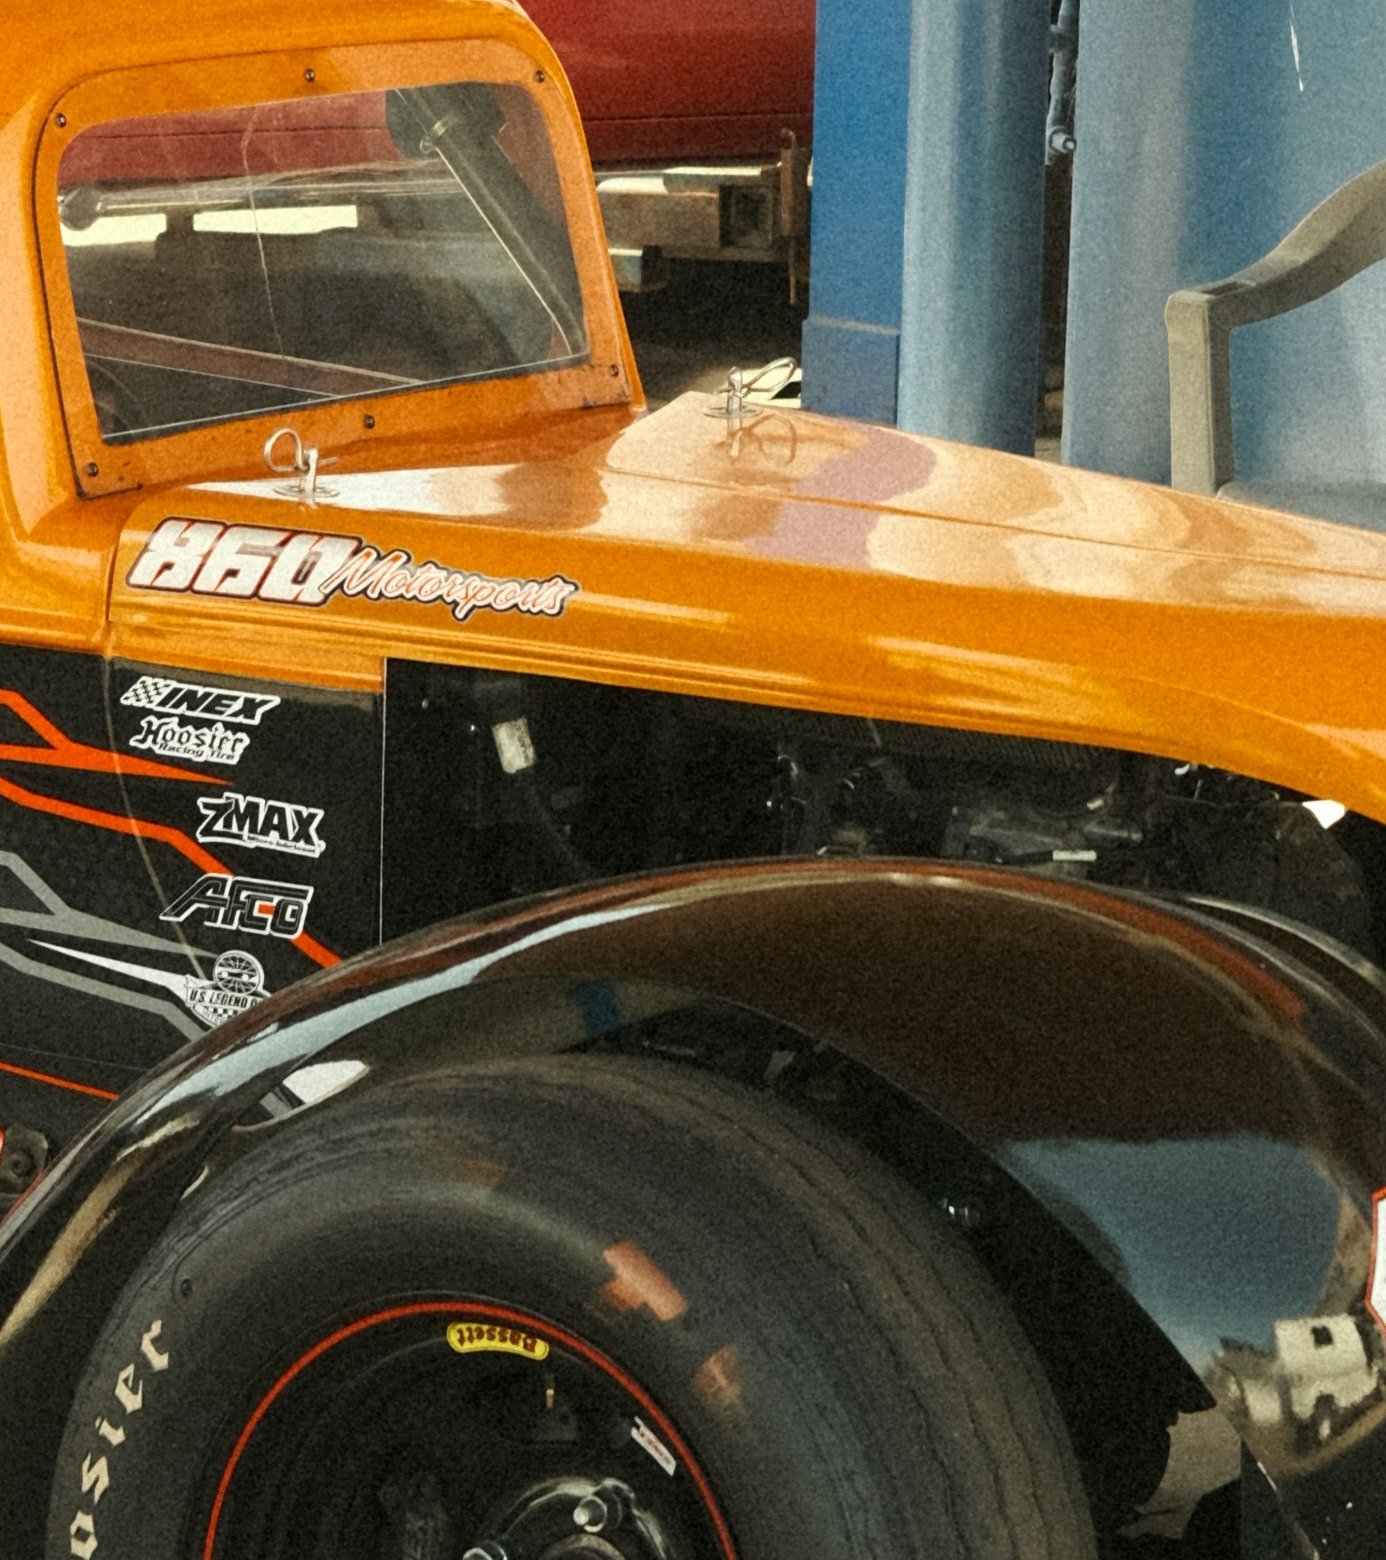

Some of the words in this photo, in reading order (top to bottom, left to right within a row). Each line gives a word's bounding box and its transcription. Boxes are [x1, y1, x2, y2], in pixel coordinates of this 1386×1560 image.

[130, 519, 359, 606] 860
[319, 547, 575, 619] Motorsports
[156, 686, 277, 721] INEX
[133, 718, 245, 753] Hoosier
[158, 742, 205, 758] Racing
[160, 873, 314, 939] AFCO
[456, 1326, 538, 1354] Bassett
